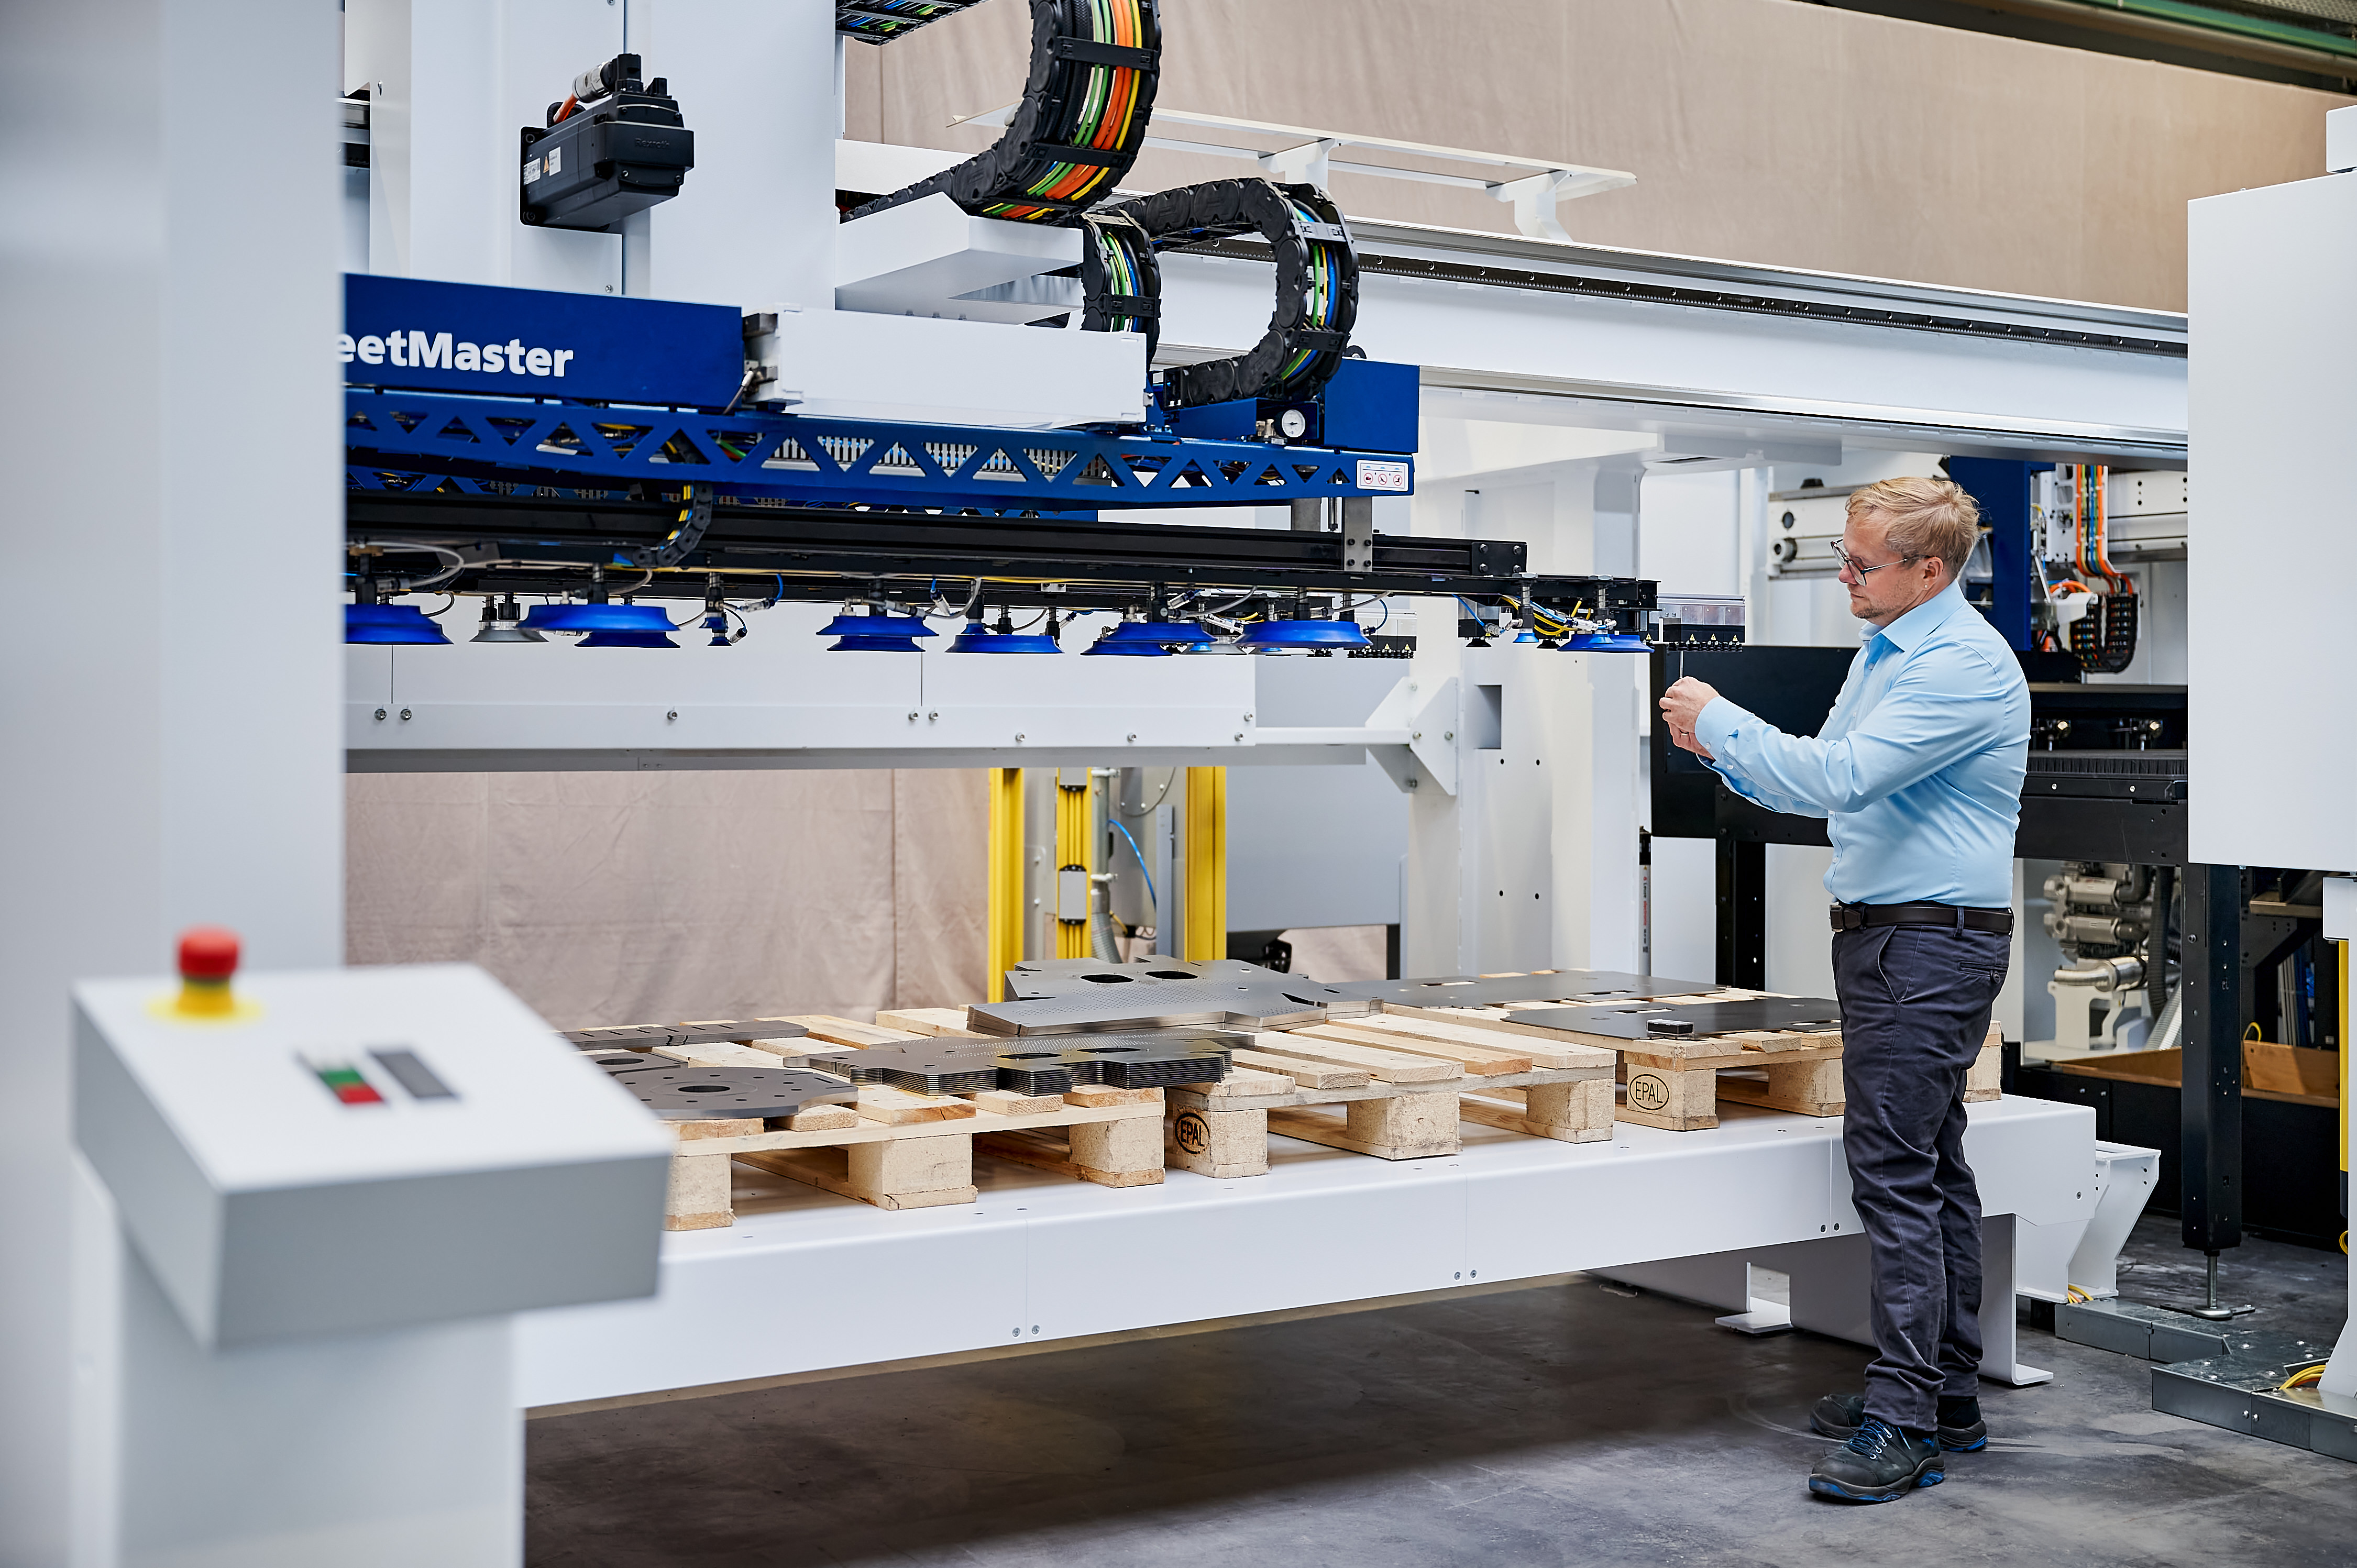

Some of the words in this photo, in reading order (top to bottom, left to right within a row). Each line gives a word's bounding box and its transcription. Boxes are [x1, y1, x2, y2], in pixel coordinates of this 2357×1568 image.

[336, 329, 574, 377] eetMaster
[1635, 1081, 1664, 1103] EPAL
[1180, 1120, 1205, 1147] EPAL
